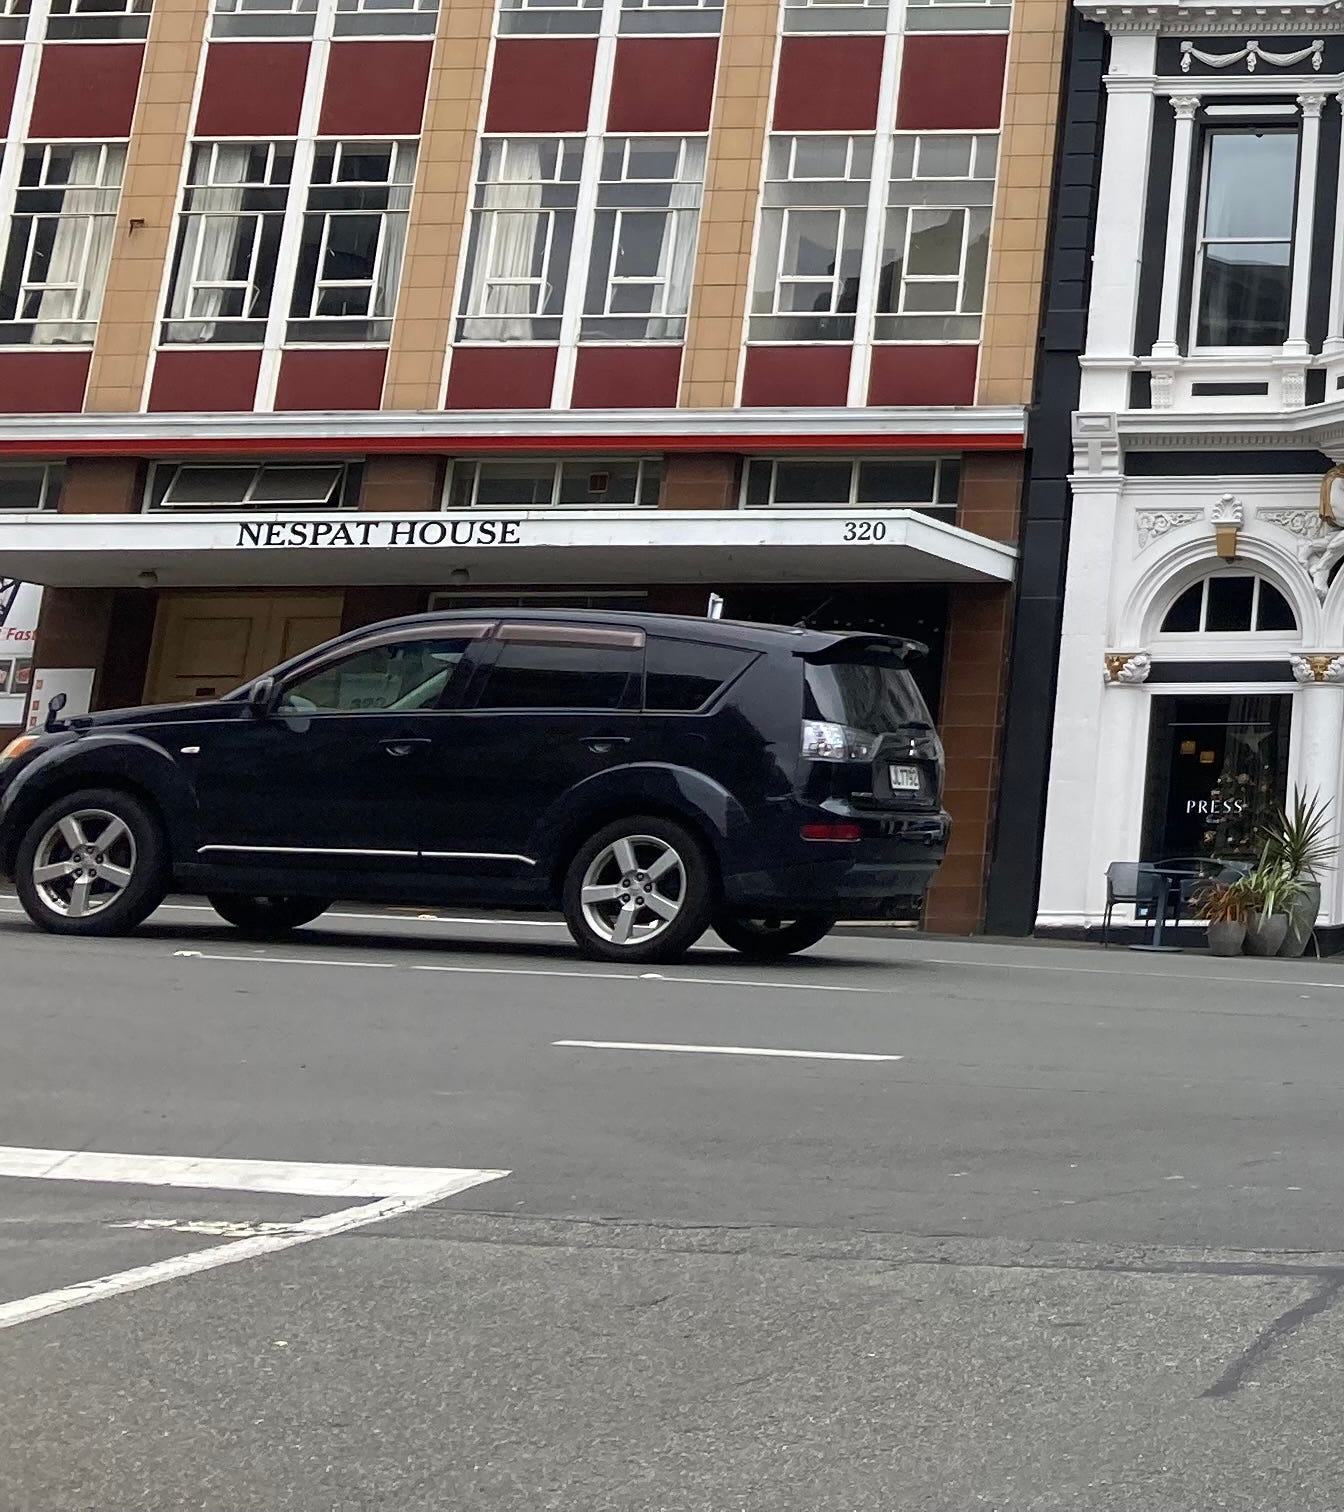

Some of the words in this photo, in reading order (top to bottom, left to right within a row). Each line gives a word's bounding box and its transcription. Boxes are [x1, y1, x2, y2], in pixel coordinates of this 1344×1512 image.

[236, 522, 378, 546] NESPAT
[387, 521, 521, 545] HOUSE
[843, 521, 886, 541] 320
[1186, 799, 1243, 814] PRESS
